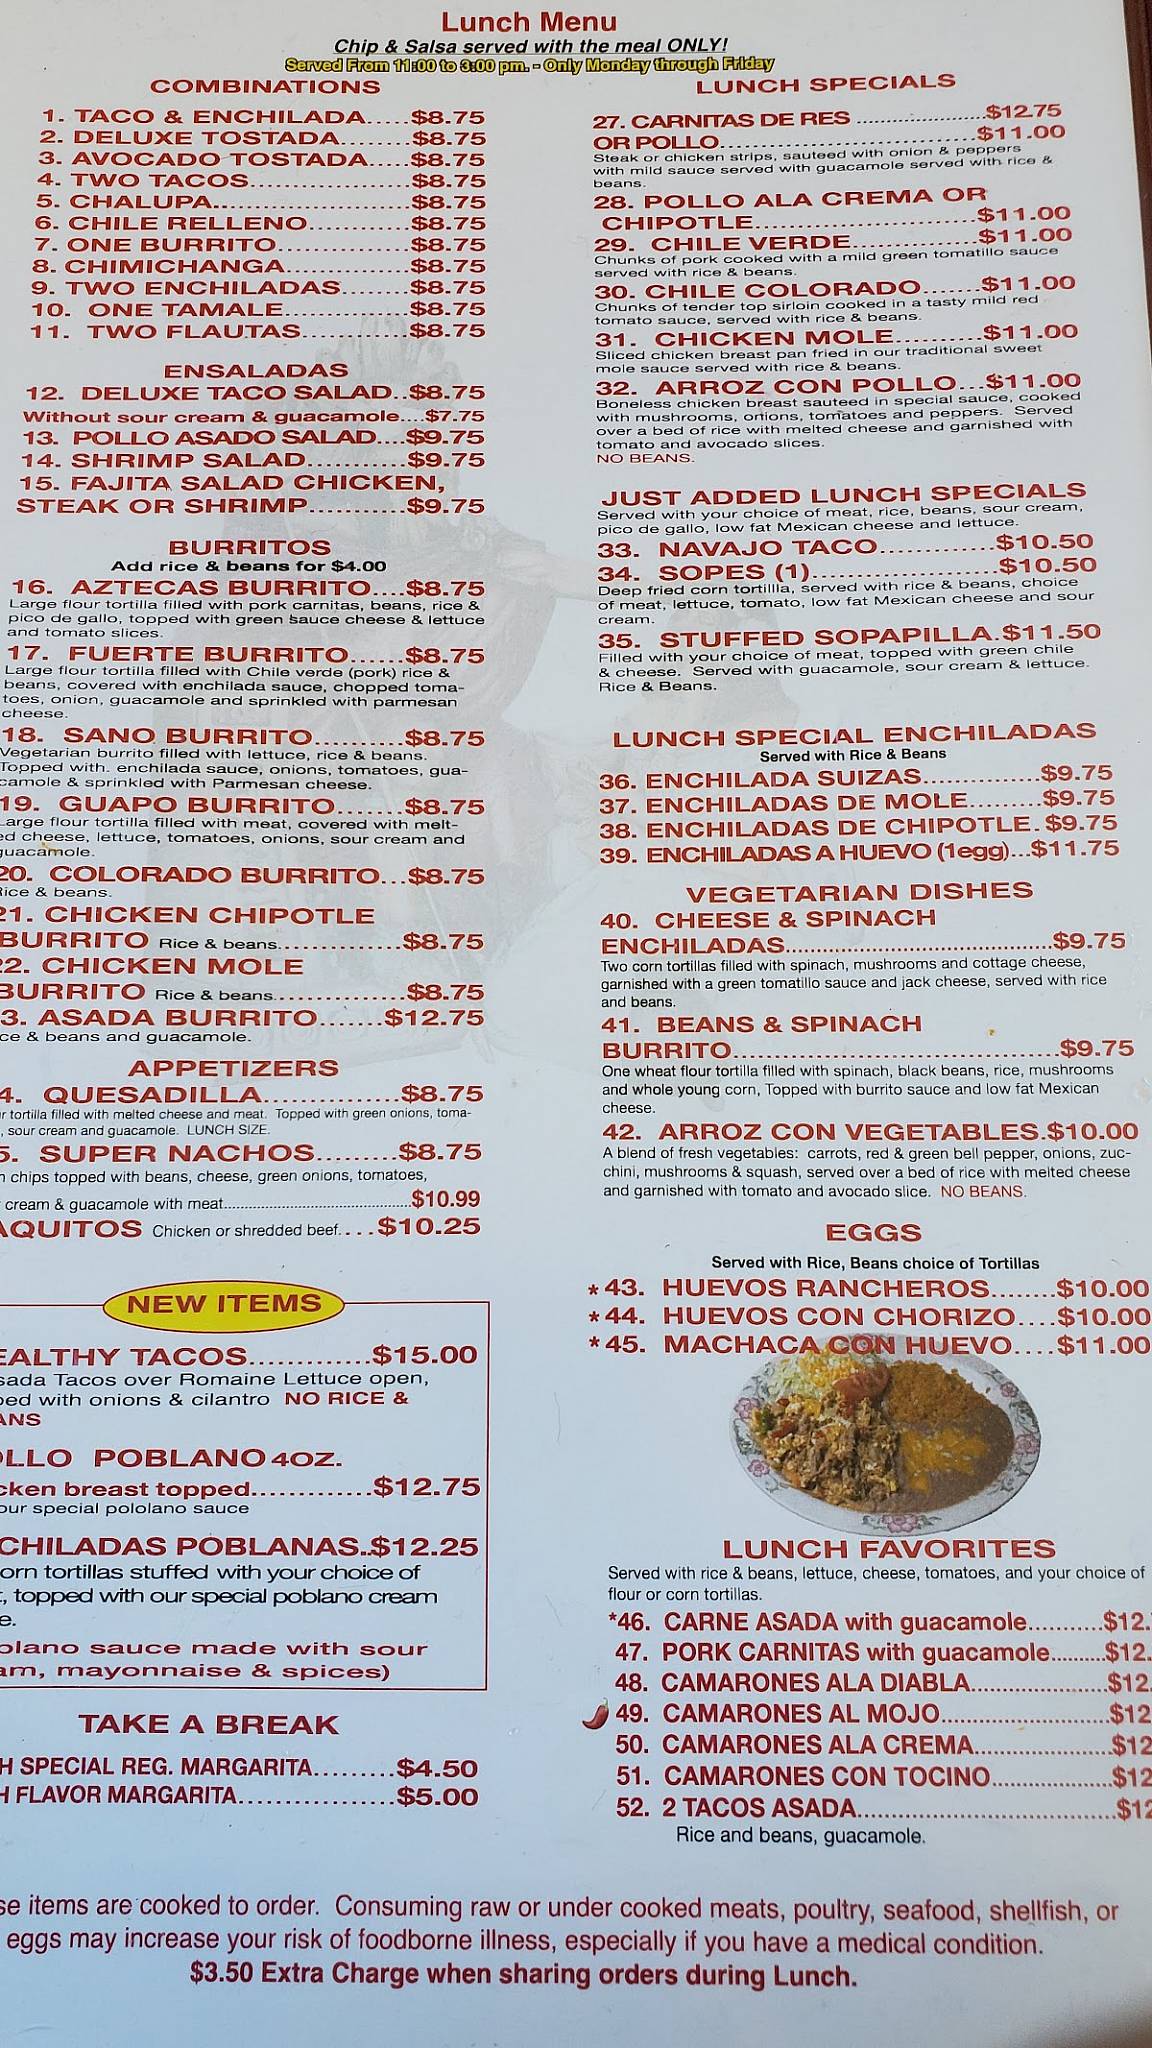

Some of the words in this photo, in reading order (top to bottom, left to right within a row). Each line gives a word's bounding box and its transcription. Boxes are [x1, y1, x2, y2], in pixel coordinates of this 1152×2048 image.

[443, 12, 529, 32] Lunch
[541, 12, 616, 31] Menu
[334, 39, 378, 56] Chip
[385, 39, 398, 53] &
[405, 39, 458, 53] Salsa
[463, 39, 528, 53] served
[534, 39, 575, 53] with
[580, 39, 610, 53] the
[615, 39, 661, 53] meal
[667, 39, 728, 53] ONLY!
[285, 58, 342, 73] Served
[346, 58, 389, 73] From
[393, 58, 437, 73] 11:00
[439, 58, 457, 73] to
[460, 58, 495, 73] 3:00
[499, 58, 530, 75] pm.
[543, 58, 581, 75] Only
[585, 57, 651, 75] Monday
[653, 57, 718, 75] through
[151, 80, 380, 94] COMBINATIONS
[697, 79, 799, 94] LUNCH
[810, 74, 955, 91] SPECIALS
[43, 109, 64, 122] 1.
[74, 109, 154, 123] TACO
[164, 110, 183, 123] &
[593, 116, 625, 129] 27.
[632, 114, 754, 128] CARNITAS
[761, 113, 794, 126] DE
[801, 111, 850, 125] RES
[593, 167, 623, 175] with
[721, 165, 773, 174] served
[779, 164, 810, 172] with
[817, 161, 904, 174] guacamole
[910, 159, 963, 168] served
[970, 158, 1002, 166] with
[1008, 157, 1035, 165] rice
[1042, 156, 1052, 164] &
[594, 196, 633, 209] 28.
[645, 195, 744, 208] POLLO
[754, 193, 812, 207] ALA
[822, 190, 933, 206] CREMA
[943, 187, 986, 201] OR
[165, 364, 348, 378] ENSALADAS
[598, 454, 623, 463] NO
[630, 454, 694, 463] BEANS.
[20, 476, 59, 490] 15.
[72, 477, 171, 491] FAJITA
[181, 476, 283, 491] SALAD
[294, 475, 444, 493] CHICKEN,
[602, 491, 681, 506] JUST
[691, 490, 800, 505] ADDED
[812, 487, 920, 503] LUNCH
[932, 483, 1086, 501] SPECIALS
[598, 525, 632, 536] pico
[639, 525, 659, 533] de
[665, 524, 708, 535] gallo,
[716, 524, 744, 532] low
[750, 523, 771, 532] fat
[778, 522, 847, 531] Mexican
[854, 522, 913, 530] cheese
[920, 520, 950, 528] and
[958, 519, 1018, 527] lettuce.
[170, 540, 331, 555] BURRITOS
[111, 561, 152, 571] Add
[160, 561, 198, 571] rice
[206, 561, 220, 571] &
[227, 561, 289, 571] beans
[296, 561, 326, 571] for
[331, 560, 386, 573] $4.00
[8, 628, 38, 636] and
[45, 628, 105, 637] tomato
[5, 680, 60, 690] beans,
[68, 681, 135, 690] covered
[143, 681, 176, 690] with
[183, 681, 265, 691] enchilada
[272, 684, 326, 693] sauce,
[334, 682, 408, 694] chopped
[415, 683, 464, 692] toma-
[614, 731, 724, 747] LUNCH
[736, 729, 873, 746] SPECIAL
[885, 723, 1096, 742] ENCHILADAS
[761, 751, 809, 762] Served
[815, 750, 844, 761] with
[850, 750, 881, 760] Rice
[887, 749, 896, 759] &
[902, 749, 946, 759] Beans
[686, 885, 897, 903] VEGETARIAN
[911, 882, 1033, 900] DISHES
[601, 913, 637, 929] 40.
[656, 912, 769, 929] CHEESE
[779, 912, 797, 928] &
[807, 910, 935, 927] SPINACH
[128, 1060, 338, 1076] APPETIZERS
[81, 1126, 104, 1135] and
[188, 1124, 234, 1135] LUNCH
[827, 1224, 921, 1242] EGGS
[128, 1295, 206, 1313] NEW
[219, 1294, 321, 1312] ITEMS
[286, 1392, 320, 1405] NO
[329, 1392, 384, 1404] RICE
[394, 1392, 408, 1404] &
[724, 1540, 847, 1559] LUNCH
[861, 1539, 1055, 1558] FAVORITES
[608, 1587, 641, 1600] flour
[646, 1591, 661, 1600] or
[666, 1591, 698, 1600] corn
[704, 1588, 761, 1600] tortillas.
[78, 1715, 169, 1733] TAKE
[180, 1715, 204, 1733] A
[217, 1715, 339, 1734] BREAK
[677, 1826, 714, 1842] Rice
[721, 1827, 752, 1842] and
[760, 1827, 817, 1845] beans,
[824, 1828, 925, 1847] guacamole.
[7, 1933, 61, 1954] eggs
[70, 1933, 116, 1953] may
[125, 1927, 219, 1948] increase
[228, 1933, 276, 1954] your
[285, 1928, 322, 1949] risk
[330, 1928, 351, 1949] of
[359, 1928, 471, 1950] foodborne
[481, 1929, 555, 1953] illness,
[566, 1930, 676, 1957] especially
[685, 1930, 696, 1951] if
[705, 1936, 744, 1957] you
[754, 1931, 807, 1952] have
[817, 1937, 830, 1952] a
[838, 1932, 925, 1954] medical
[934, 1933, 1042, 1955] condition.
[190, 1960, 253, 1984] $3.50
[262, 1962, 323, 1983] Extra
[333, 1962, 419, 1989] Charge
[427, 1963, 491, 1984] when
[499, 1963, 590, 1989] sharing
[599, 1964, 677, 1985] orders
[686, 1964, 764, 1991] during
[775, 1965, 856, 1987] Lunch.
